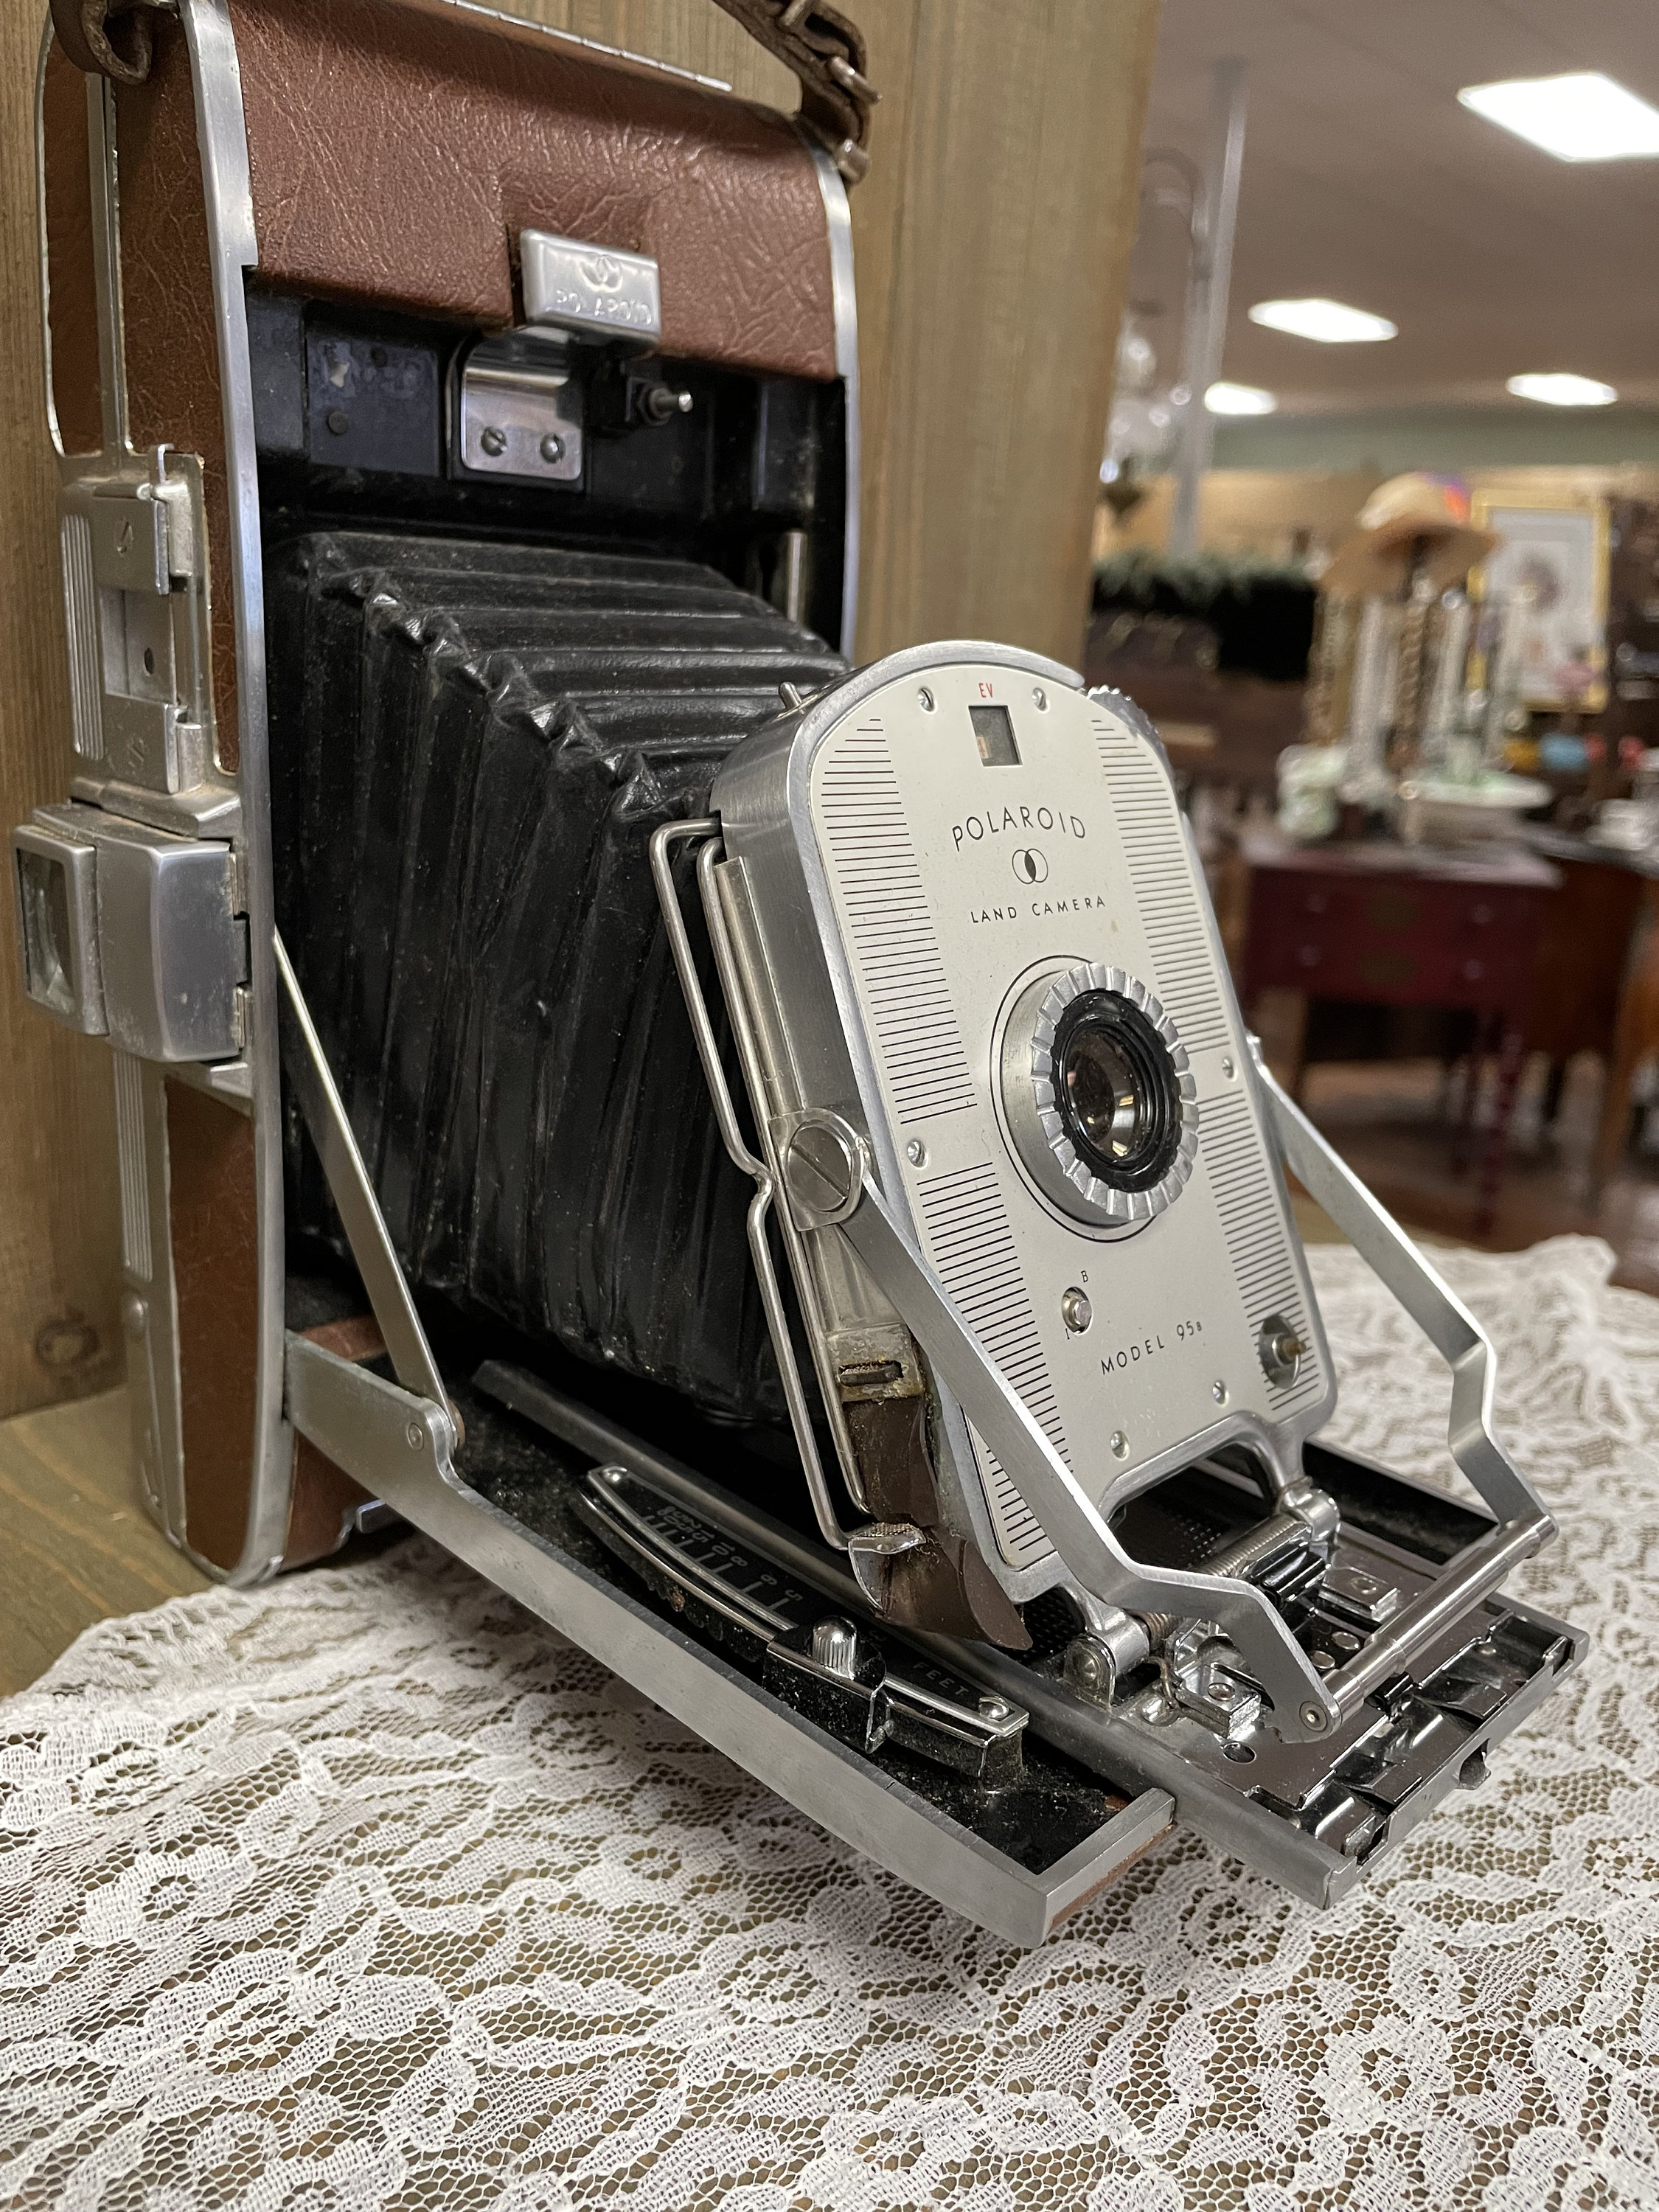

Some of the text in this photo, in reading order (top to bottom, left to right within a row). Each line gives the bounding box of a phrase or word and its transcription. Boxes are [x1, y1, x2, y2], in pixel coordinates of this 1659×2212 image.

[978, 682, 993, 698] EV
[952, 806, 1086, 852] POLAROID
[970, 895, 1107, 924] LAND CAMERA
[1080, 1270, 1089, 1283] B
[1100, 1335, 1165, 1376] MODEL
[712, 1541, 736, 1556] 10
[913, 1660, 969, 1695] FEET
